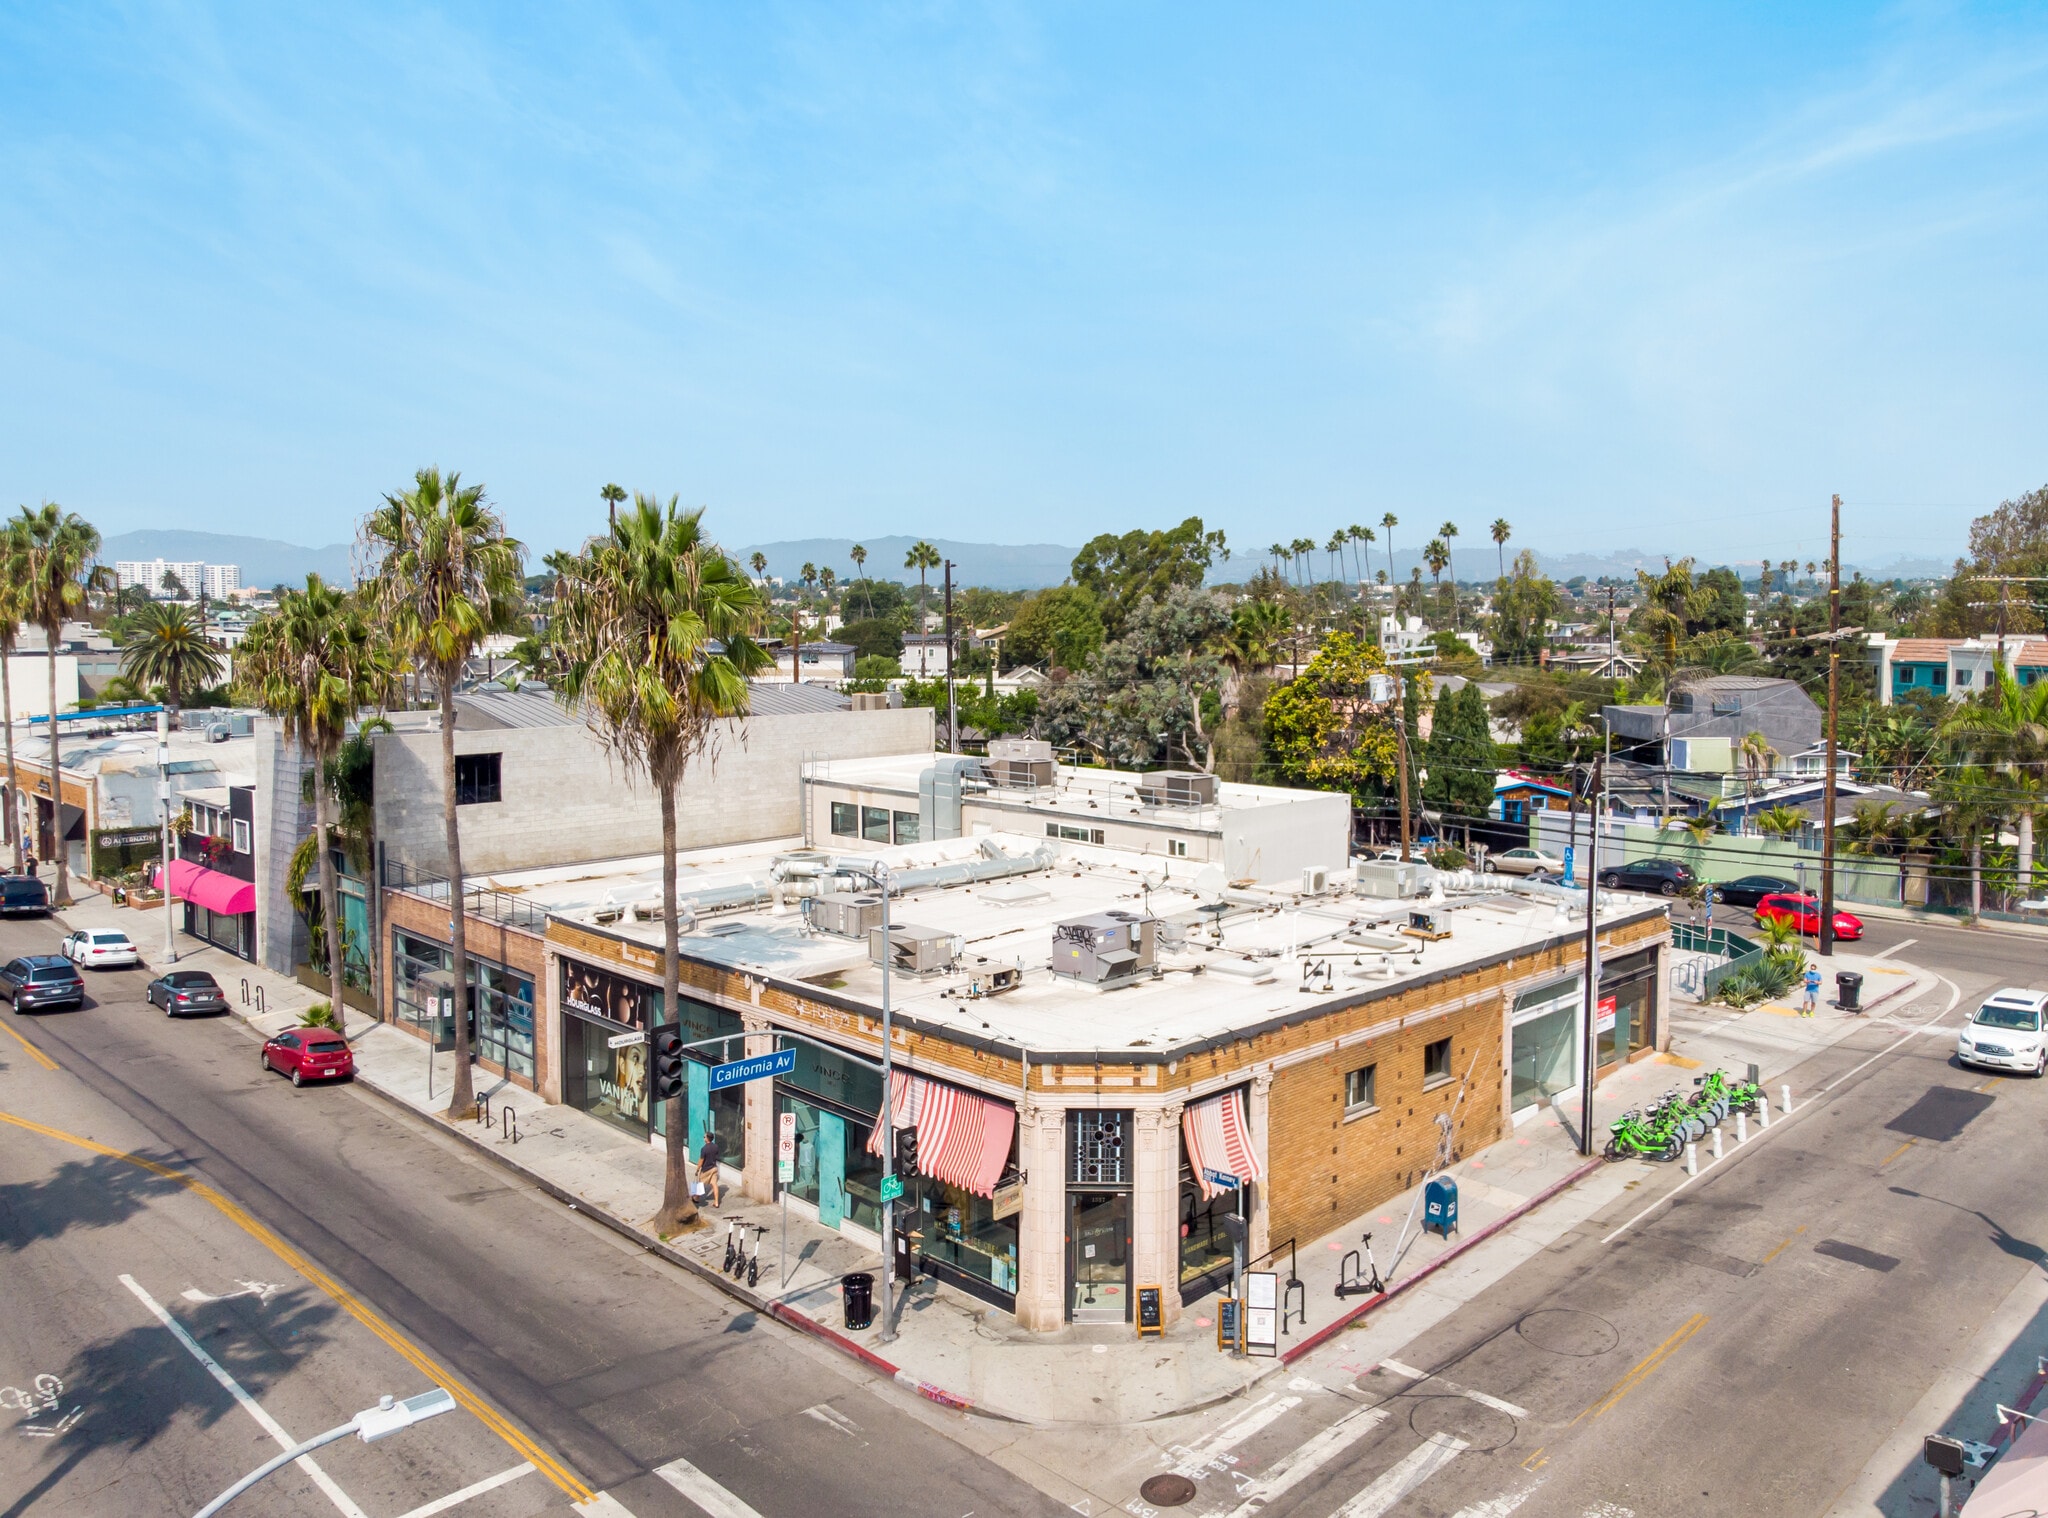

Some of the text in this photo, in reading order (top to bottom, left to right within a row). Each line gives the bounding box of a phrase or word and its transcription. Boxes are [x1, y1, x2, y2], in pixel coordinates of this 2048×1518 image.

[566, 996, 602, 1017] HOURGLASS
[682, 1018, 714, 1035] VINCE
[716, 1056, 791, 1083] California Av
[812, 1063, 851, 1083] VINCE
